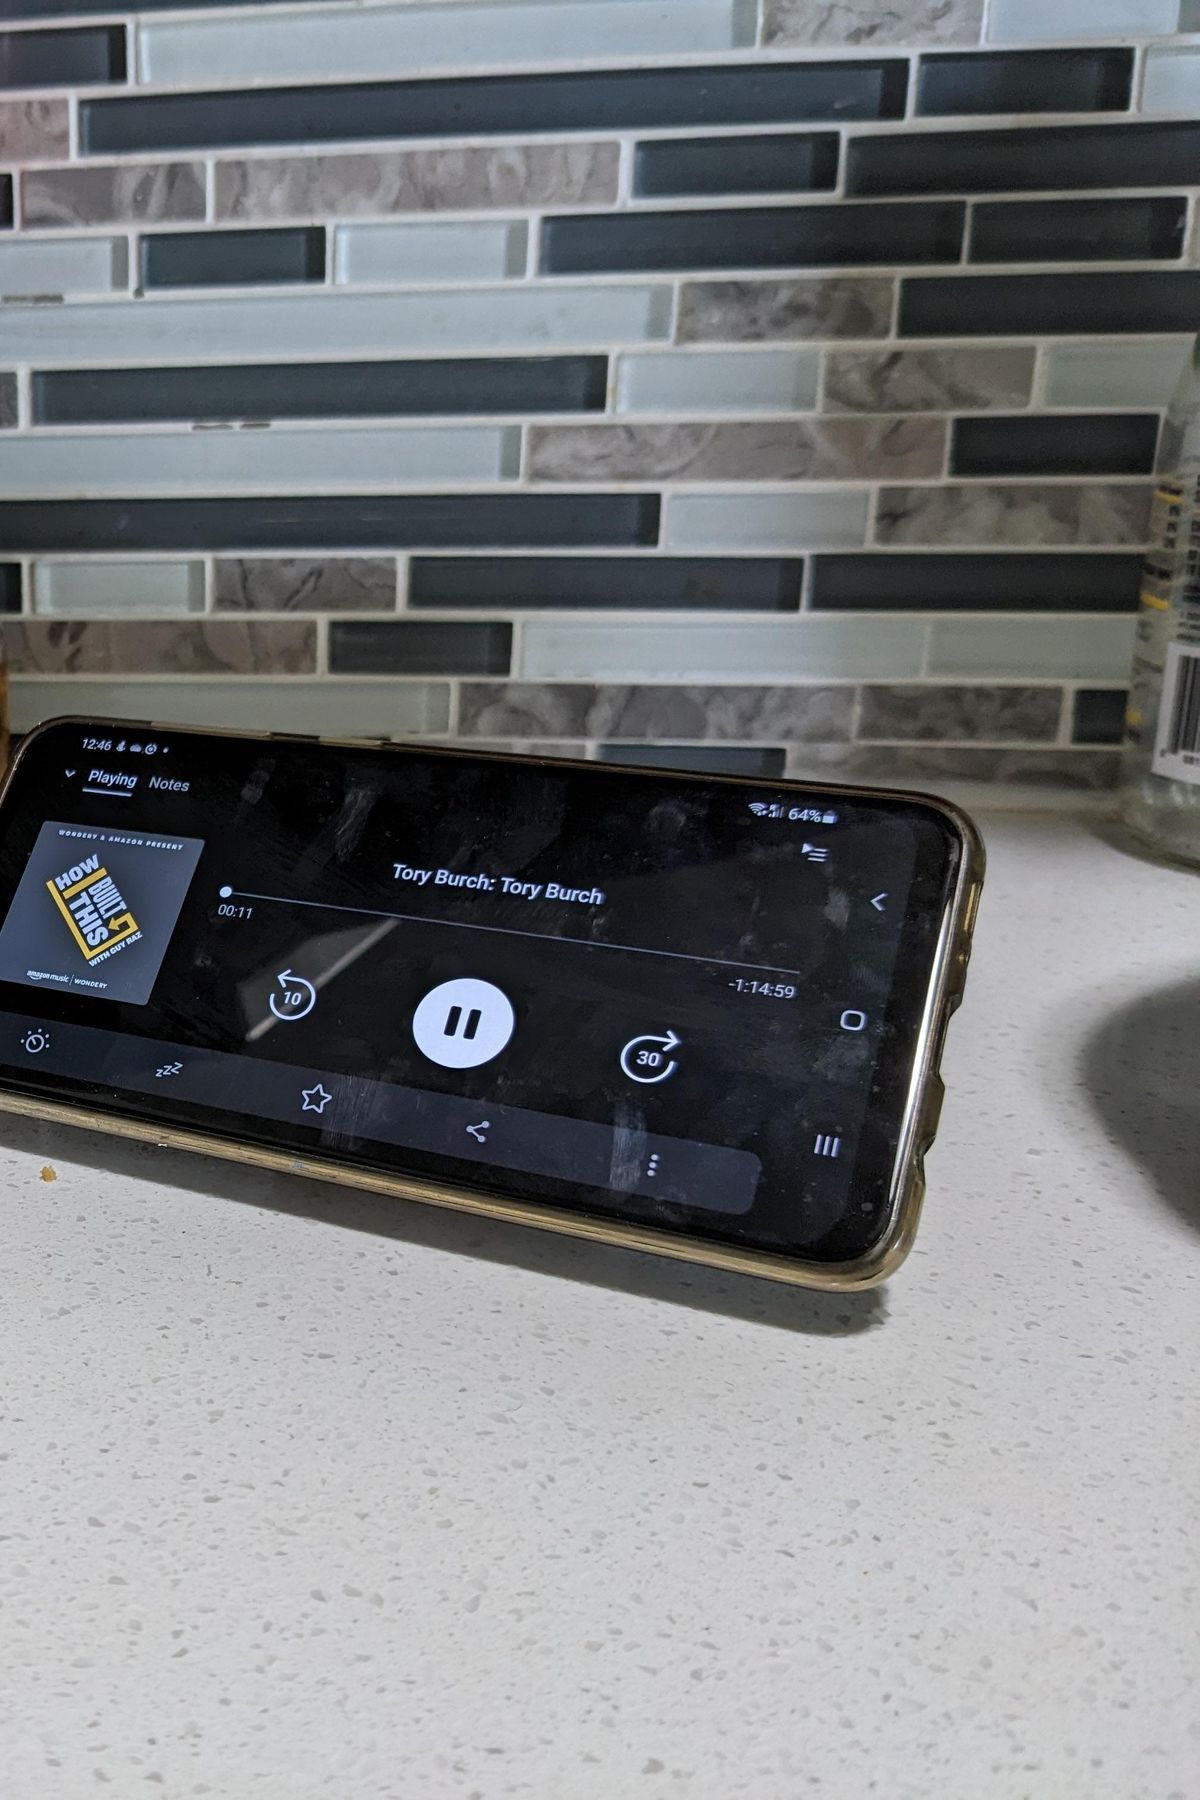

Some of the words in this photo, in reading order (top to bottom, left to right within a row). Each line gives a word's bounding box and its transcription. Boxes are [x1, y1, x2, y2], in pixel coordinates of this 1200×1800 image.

[82, 738, 112, 751] 12:46
[88, 769, 138, 789] Playing
[148, 776, 190, 792] Notes
[788, 807, 822, 823] 64%
[58, 829, 97, 840] WONDERY
[108, 835, 143, 846] AMAZON
[146, 840, 183, 851] PRESENT
[54, 853, 100, 891] HOW
[392, 862, 432, 886] Tory
[434, 869, 497, 891] Burch:
[500, 877, 543, 900] Tory
[545, 883, 604, 905] Burch
[88, 876, 128, 920] BUILT
[69, 891, 109, 946] THIS
[218, 904, 253, 920] 00:11
[88, 950, 111, 967] WITH
[109, 940, 127, 956] GUY
[126, 931, 143, 945] RAZ
[74, 977, 108, 989] WONDERY
[728, 978, 795, 999] -1:14:59
[282, 990, 302, 1006] 10
[636, 1049, 660, 1067] 30
